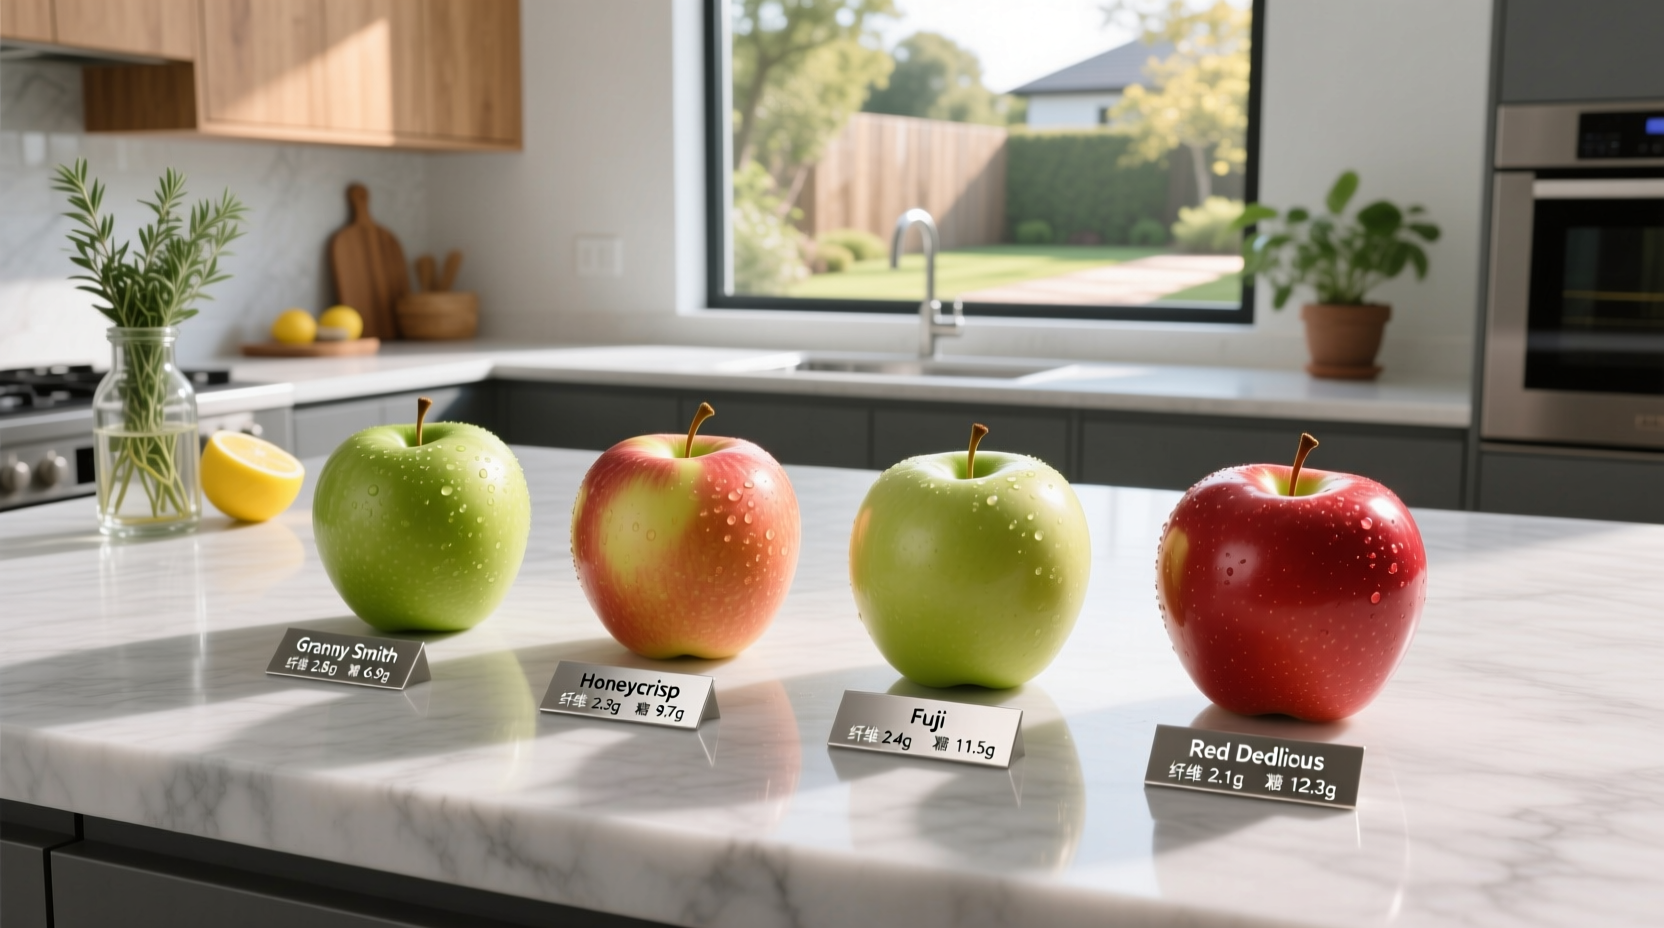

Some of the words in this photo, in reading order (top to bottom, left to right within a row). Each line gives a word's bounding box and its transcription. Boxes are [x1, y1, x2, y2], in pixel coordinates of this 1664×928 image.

[296, 636, 350, 661] Granny
[351, 643, 398, 664] Smith
[363, 666, 390, 684] 6.9g
[579, 672, 681, 703] Honeycrisp
[655, 704, 685, 722] 9.7g
[910, 708, 947, 733] Fuji
[956, 738, 996, 760] 11.5g
[1188, 738, 1231, 761] Red
[1207, 767, 1244, 790] 2.1g
[1290, 777, 1337, 801] 12.3g
